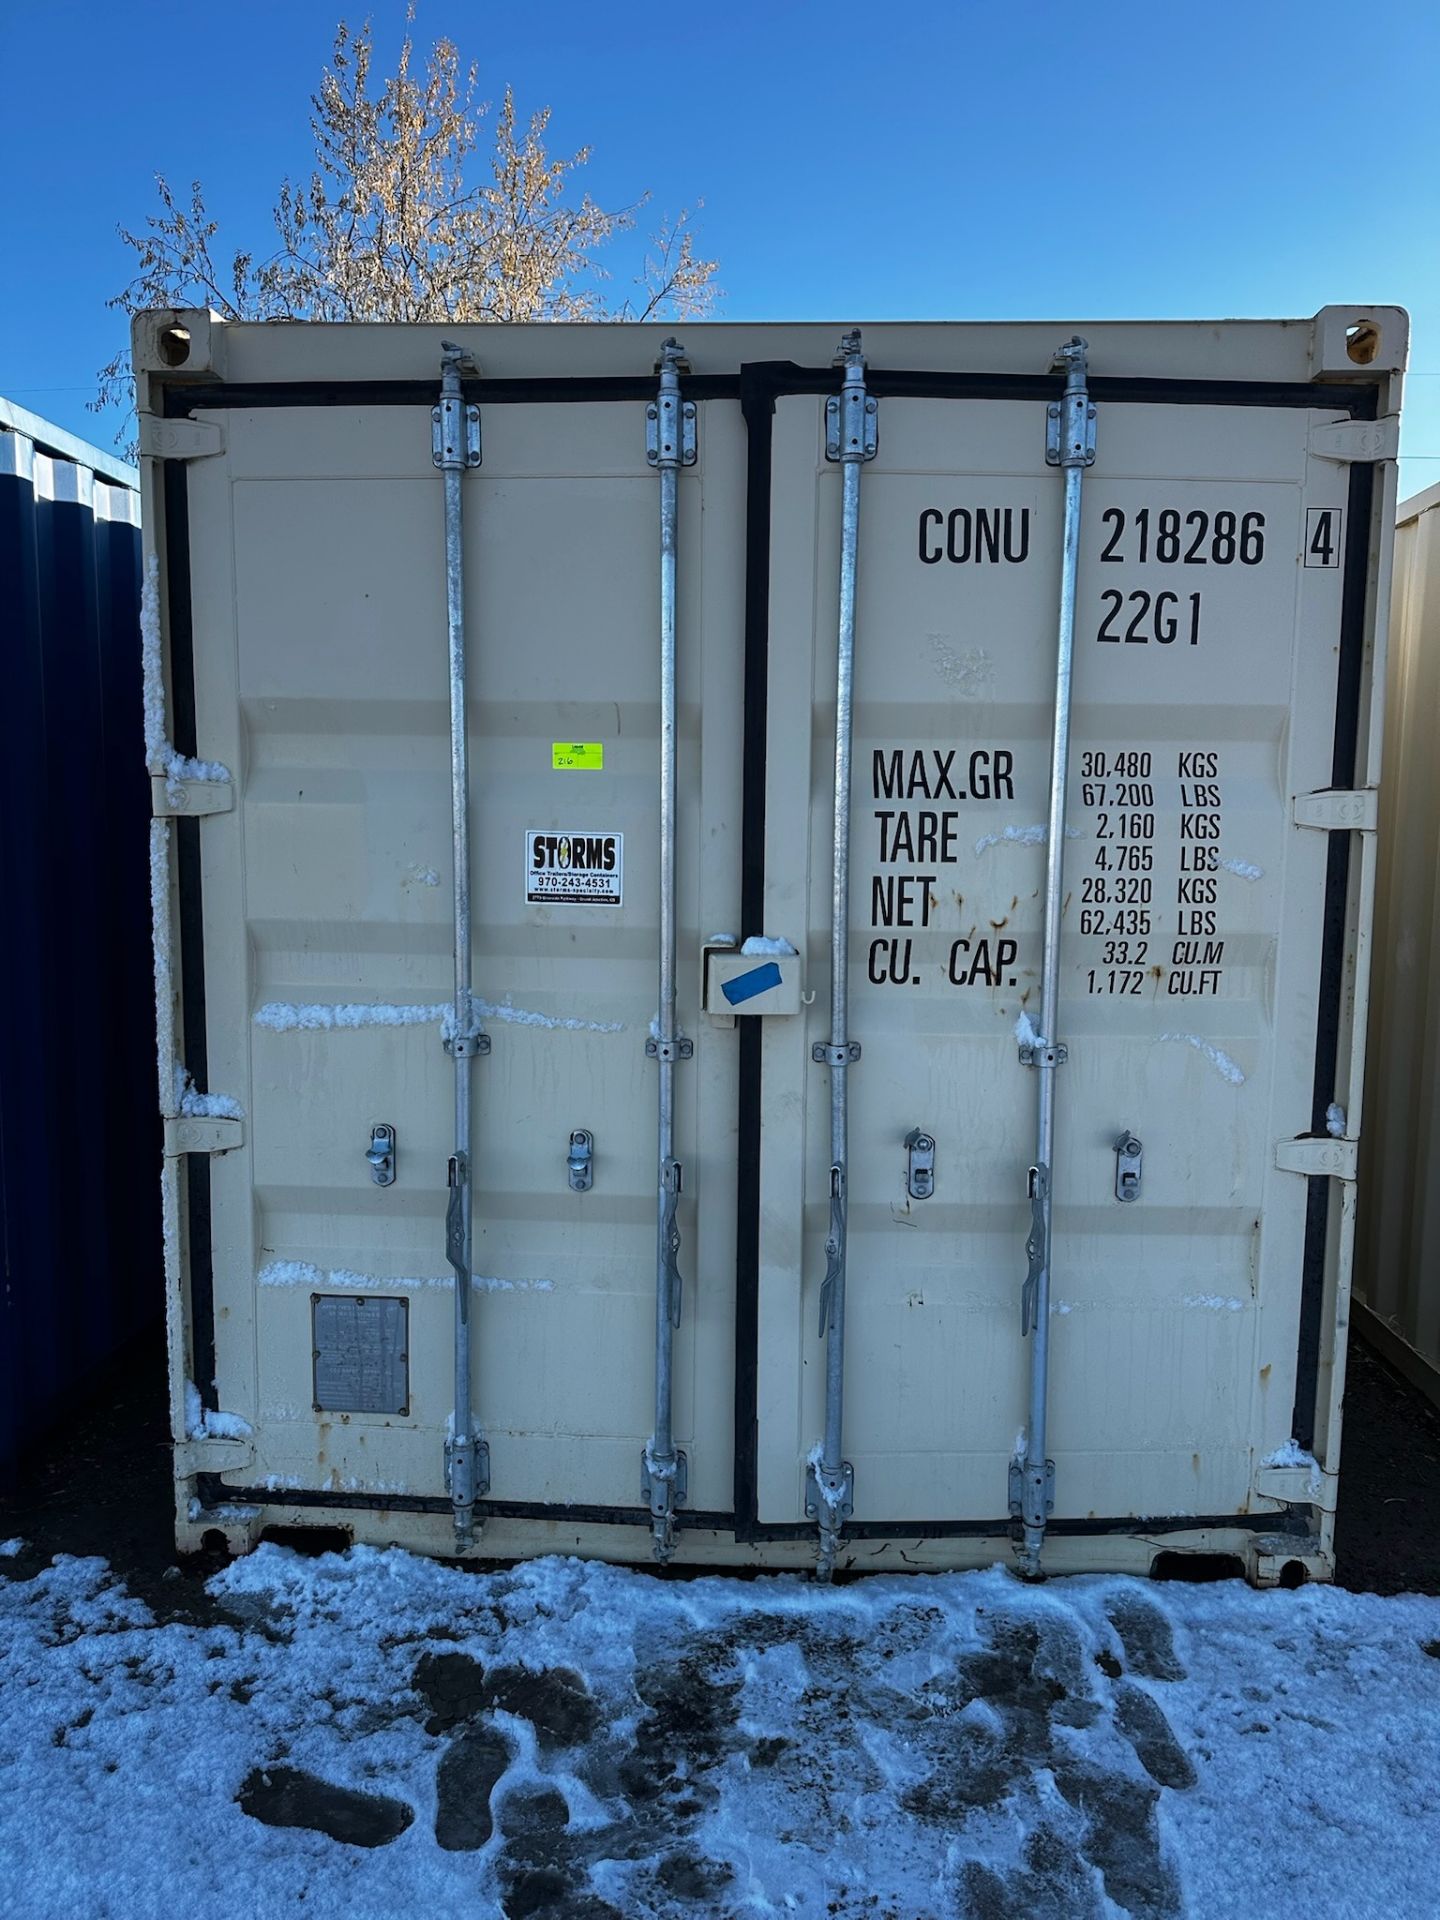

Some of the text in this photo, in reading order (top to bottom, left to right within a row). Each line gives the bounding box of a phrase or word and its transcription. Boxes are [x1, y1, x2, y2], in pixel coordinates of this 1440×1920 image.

[919, 508, 1334, 565] CONU 218286 4
[1096, 589, 1201, 645] 22G1
[872, 749, 1014, 800] MAX.GR
[1081, 752, 1218, 778] 30,480 KGS
[1082, 783, 1221, 807] 67,200 LBS
[875, 811, 959, 863] TARE
[1096, 813, 1221, 839] 2,160 KGS
[533, 835, 616, 871] STORMS
[1094, 846, 1219, 872] 4,765 LBS
[538, 876, 611, 888] 970-243-4531
[1081, 878, 1217, 904] 28,320 KGS
[871, 876, 937, 927] NET
[1080, 910, 1216, 936] 62,435 LBS
[868, 938, 1018, 987] CU. CAP.
[1102, 941, 1225, 965] 33.2 CU.M
[1087, 970, 1223, 995] 1,172 CU.FT
